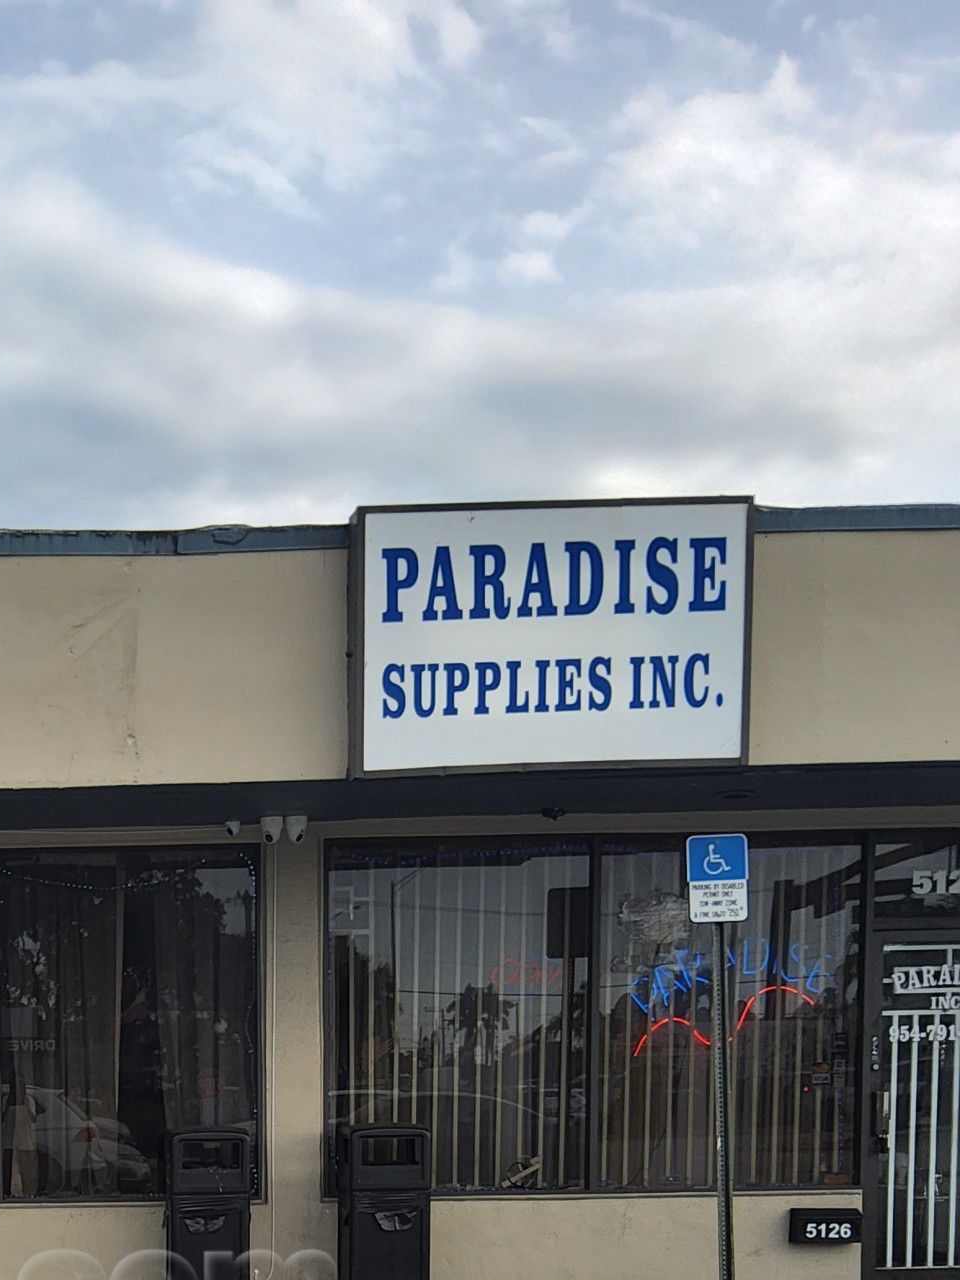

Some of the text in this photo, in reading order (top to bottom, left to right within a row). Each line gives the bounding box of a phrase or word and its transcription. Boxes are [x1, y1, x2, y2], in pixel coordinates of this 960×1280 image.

[381, 536, 727, 623] PARADISE
[381, 653, 724, 719] SUPPLIES INC.
[805, 1223, 852, 1239] 5126
